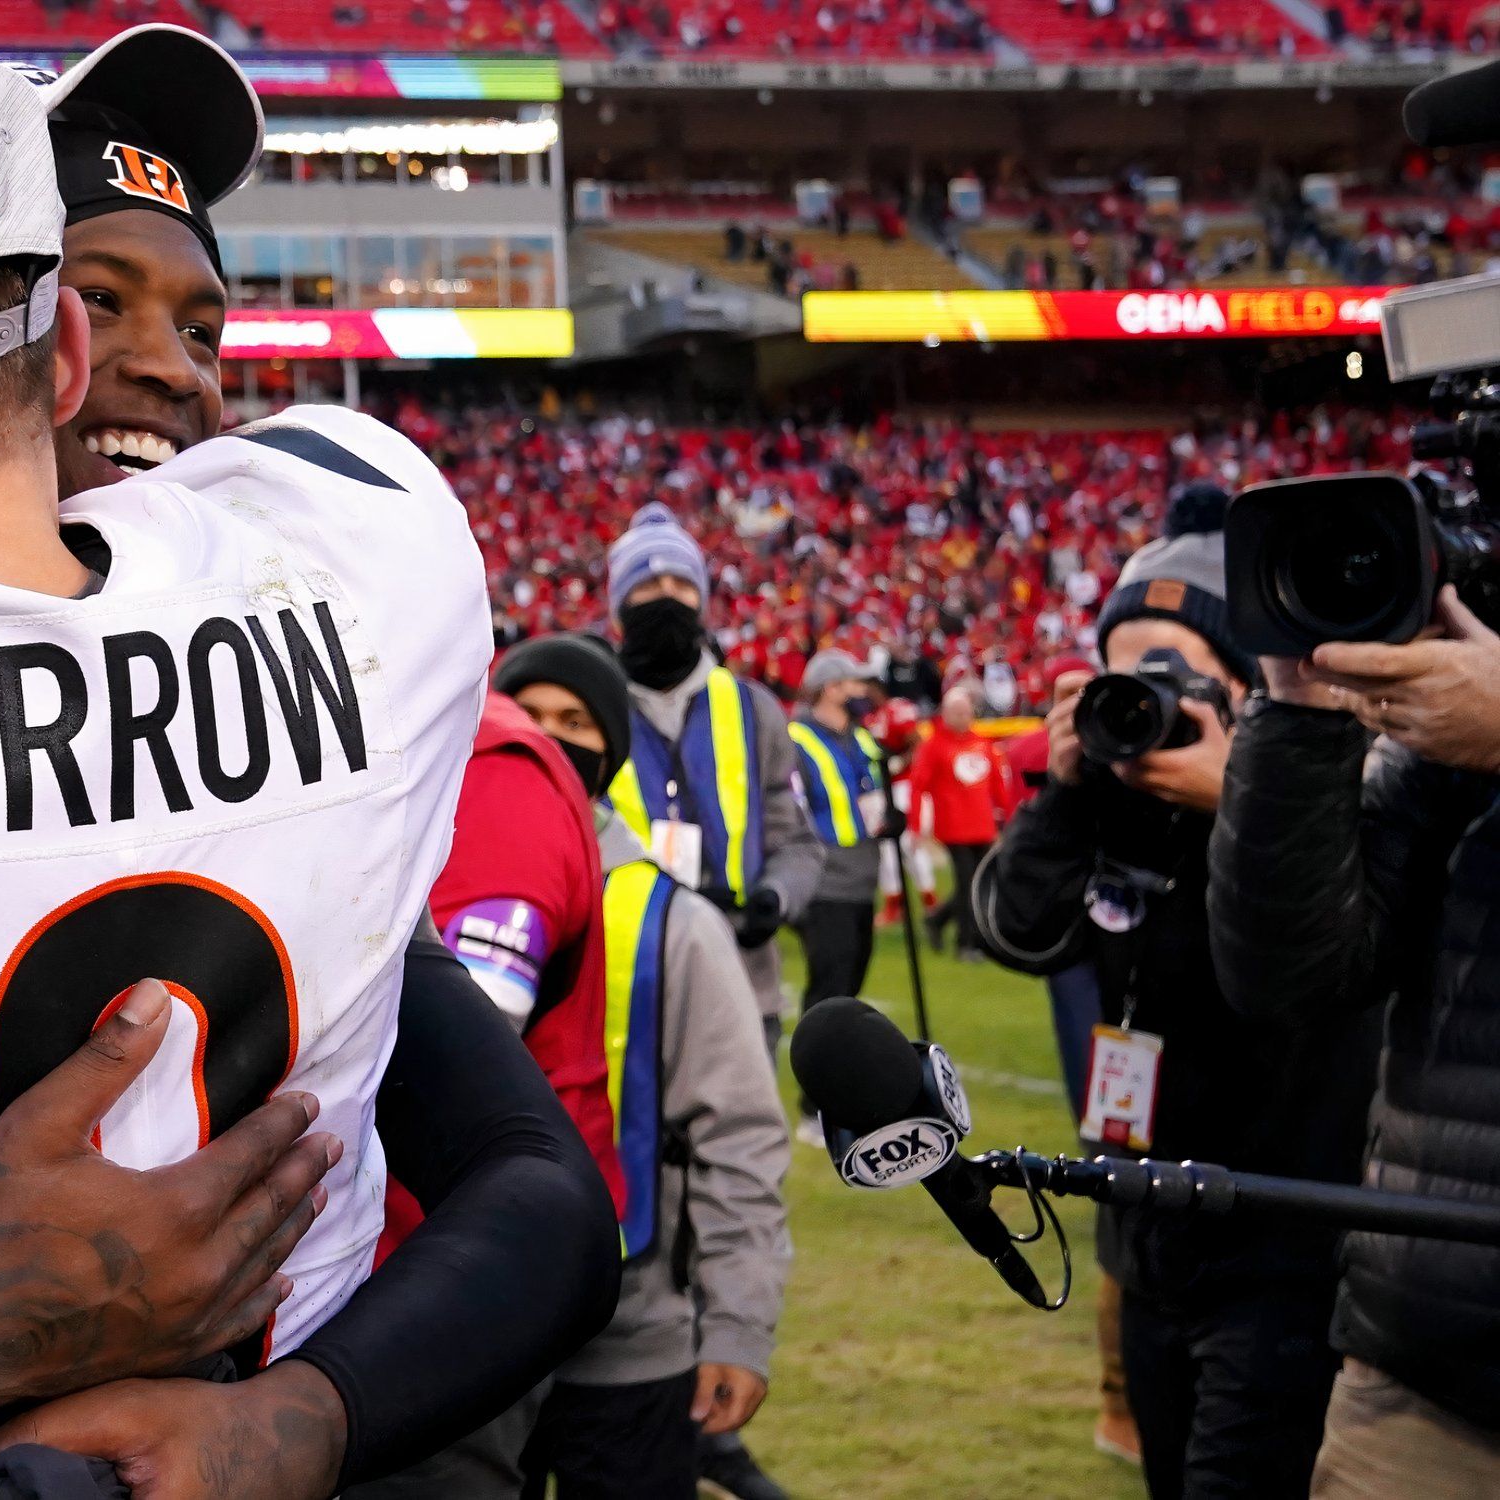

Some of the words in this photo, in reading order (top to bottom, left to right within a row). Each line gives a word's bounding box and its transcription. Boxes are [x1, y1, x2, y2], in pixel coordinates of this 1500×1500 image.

[1227, 291, 1336, 331] FIELD
[860, 1127, 933, 1174] FOX
[874, 1146, 941, 1184] SPORTS
